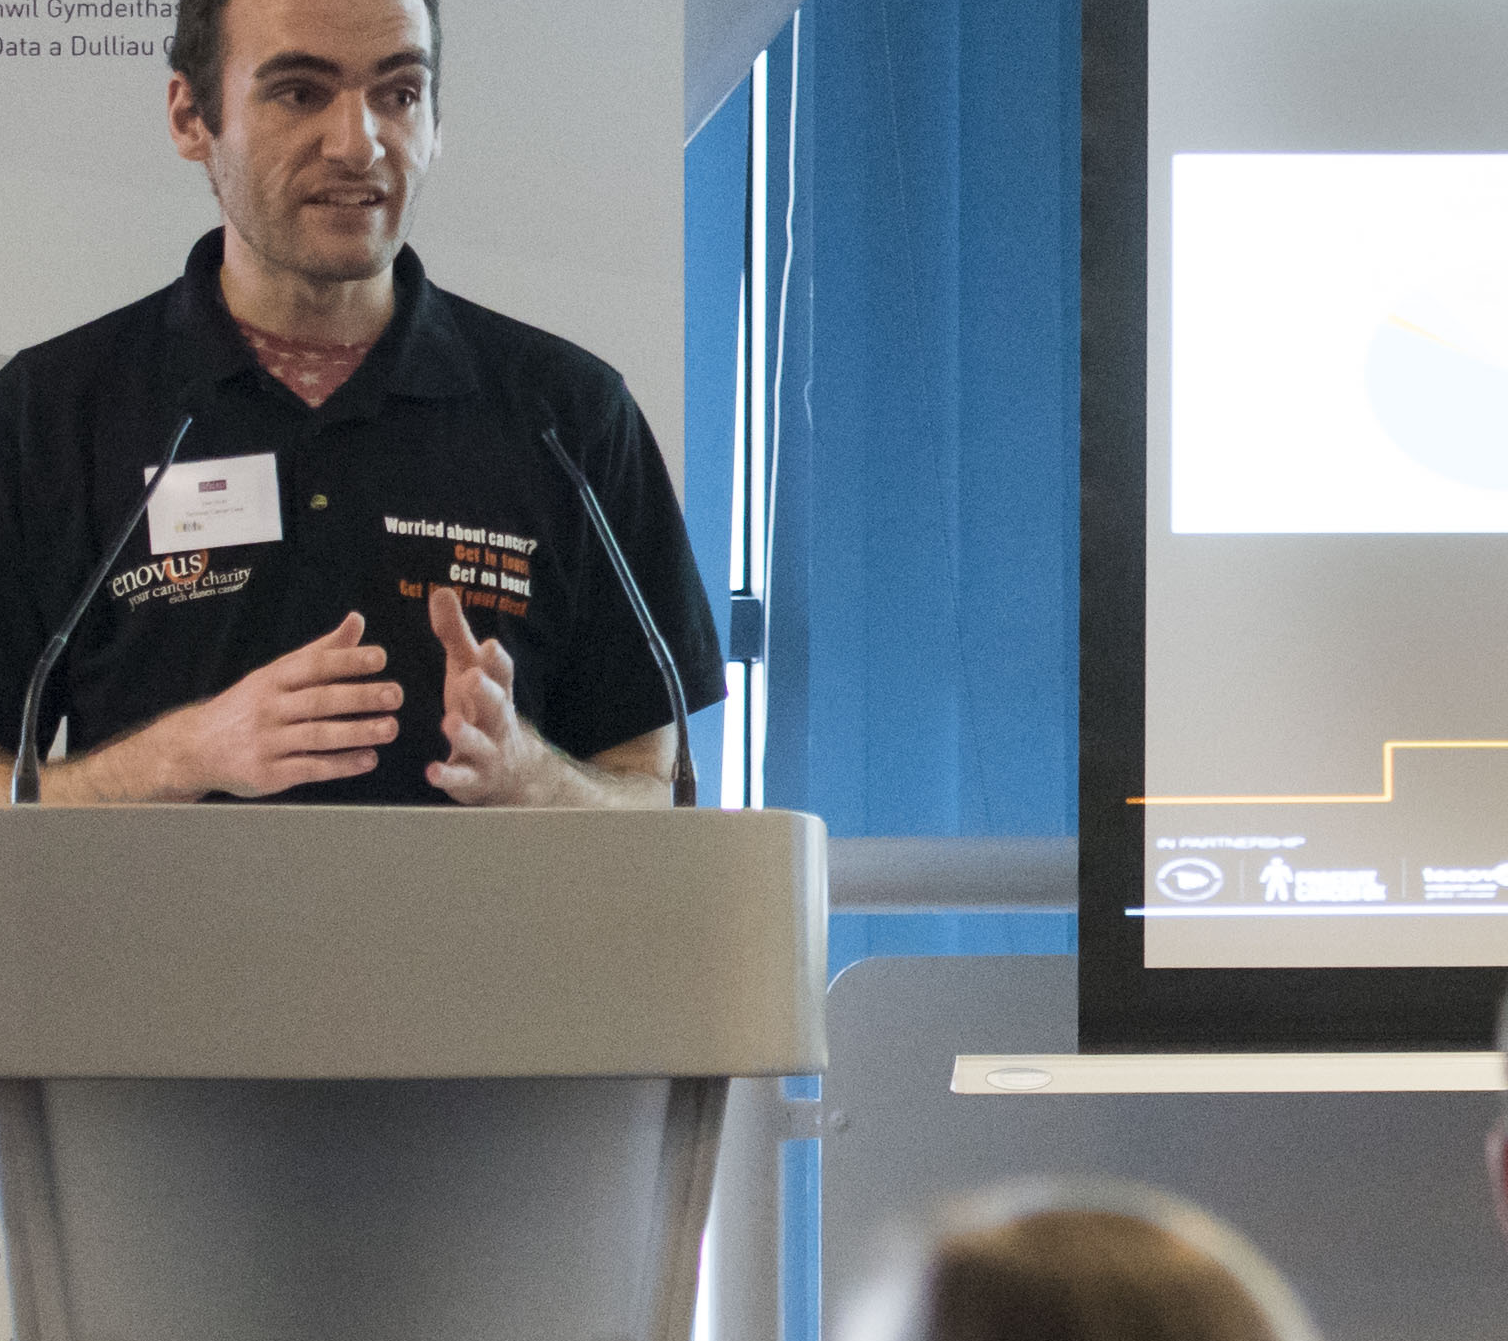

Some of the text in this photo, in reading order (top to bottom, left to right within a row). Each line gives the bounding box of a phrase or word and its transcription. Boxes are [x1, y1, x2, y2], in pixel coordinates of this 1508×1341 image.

[49, 41, 62, 56] a
[71, 35, 154, 57] Dulliau
[383, 516, 539, 557] Worried about cancer?
[109, 551, 203, 598] enovus
[152, 578, 199, 599] cancer
[201, 566, 253, 588] charity
[449, 563, 477, 583] Get
[480, 570, 498, 587] on
